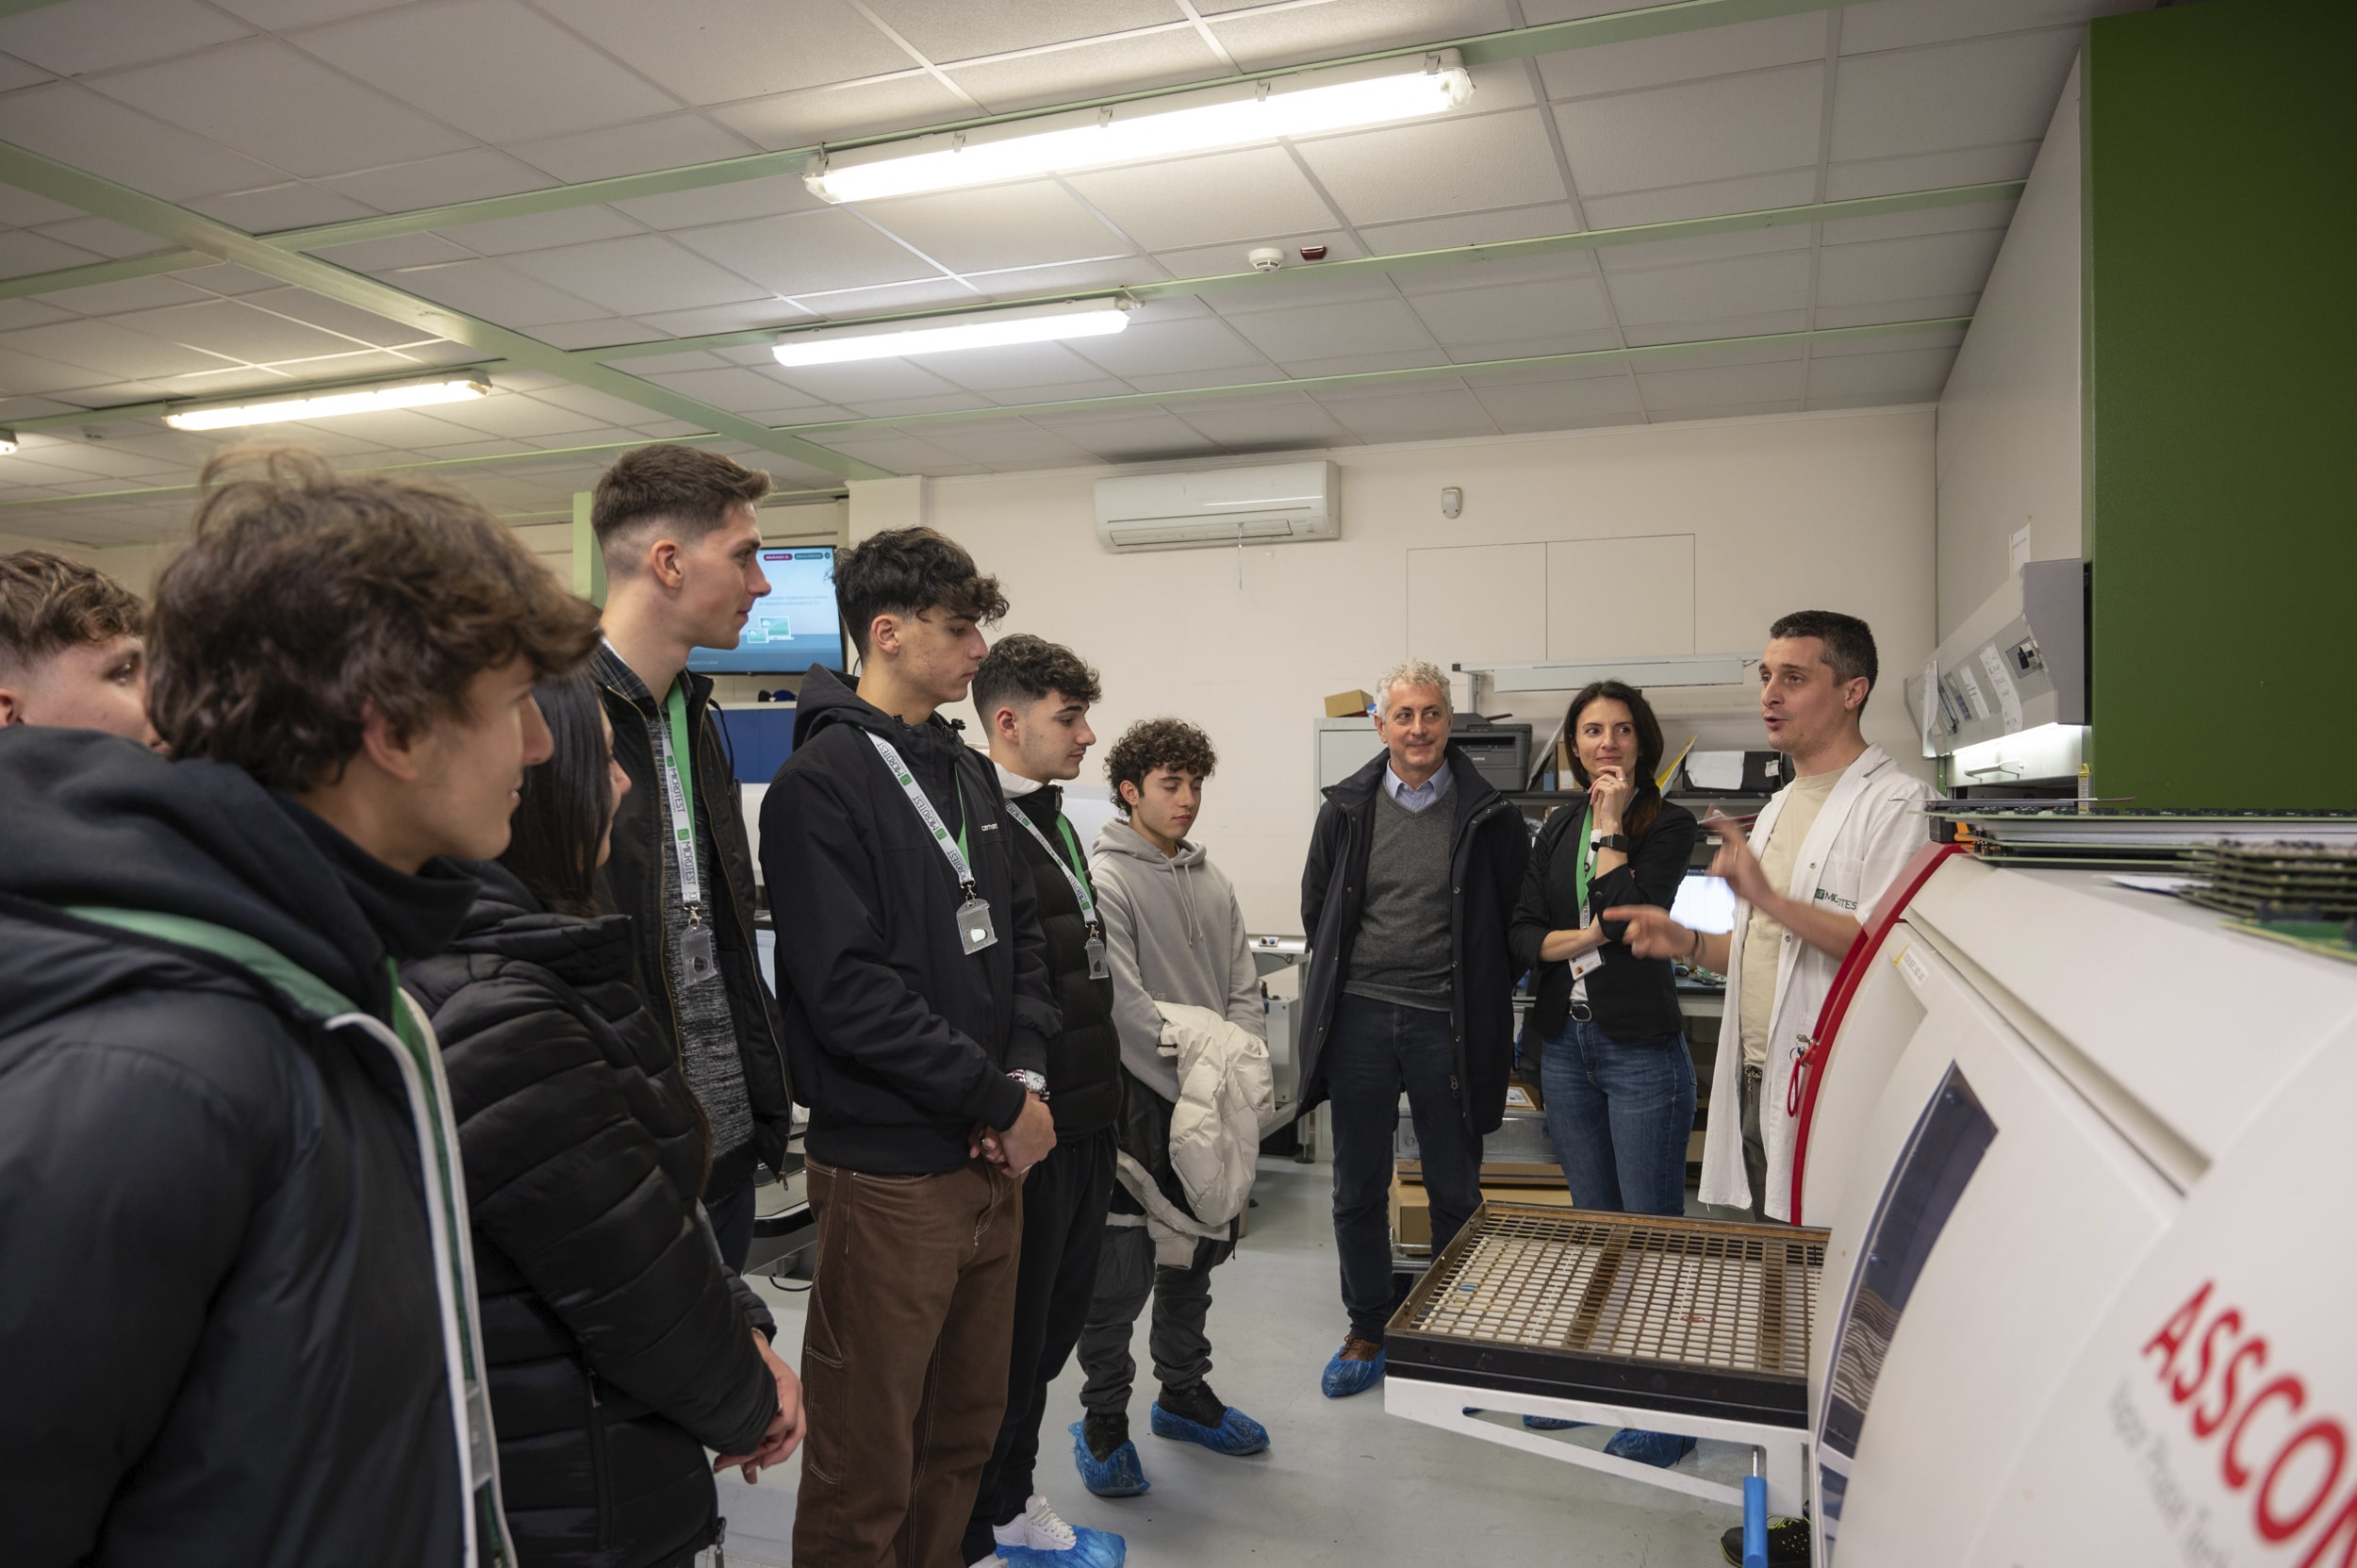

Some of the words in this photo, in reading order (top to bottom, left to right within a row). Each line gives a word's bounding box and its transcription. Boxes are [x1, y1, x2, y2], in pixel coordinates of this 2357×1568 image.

[877, 742, 903, 777] MICROTEST
[670, 768, 685, 813] MICROTEST
[913, 796, 938, 831] MICROTEST
[1006, 804, 1022, 820] MICRO
[683, 841, 696, 886] MICROTEST
